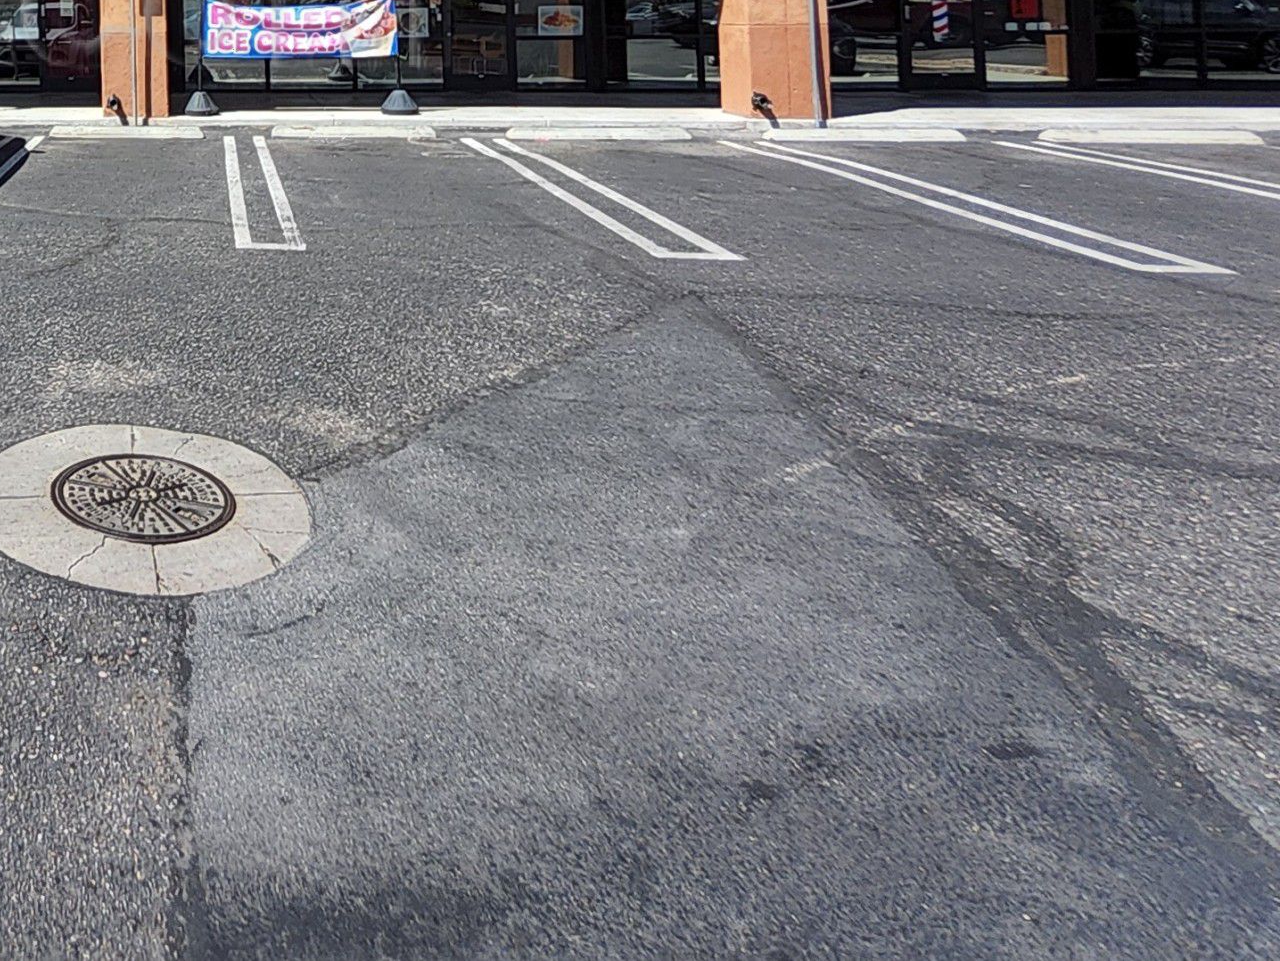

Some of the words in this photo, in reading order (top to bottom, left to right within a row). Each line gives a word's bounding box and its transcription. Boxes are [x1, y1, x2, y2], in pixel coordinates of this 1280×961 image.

[209, 2, 347, 30] ROLLED
[209, 31, 249, 52] ICE
[255, 31, 350, 53] CREAM
